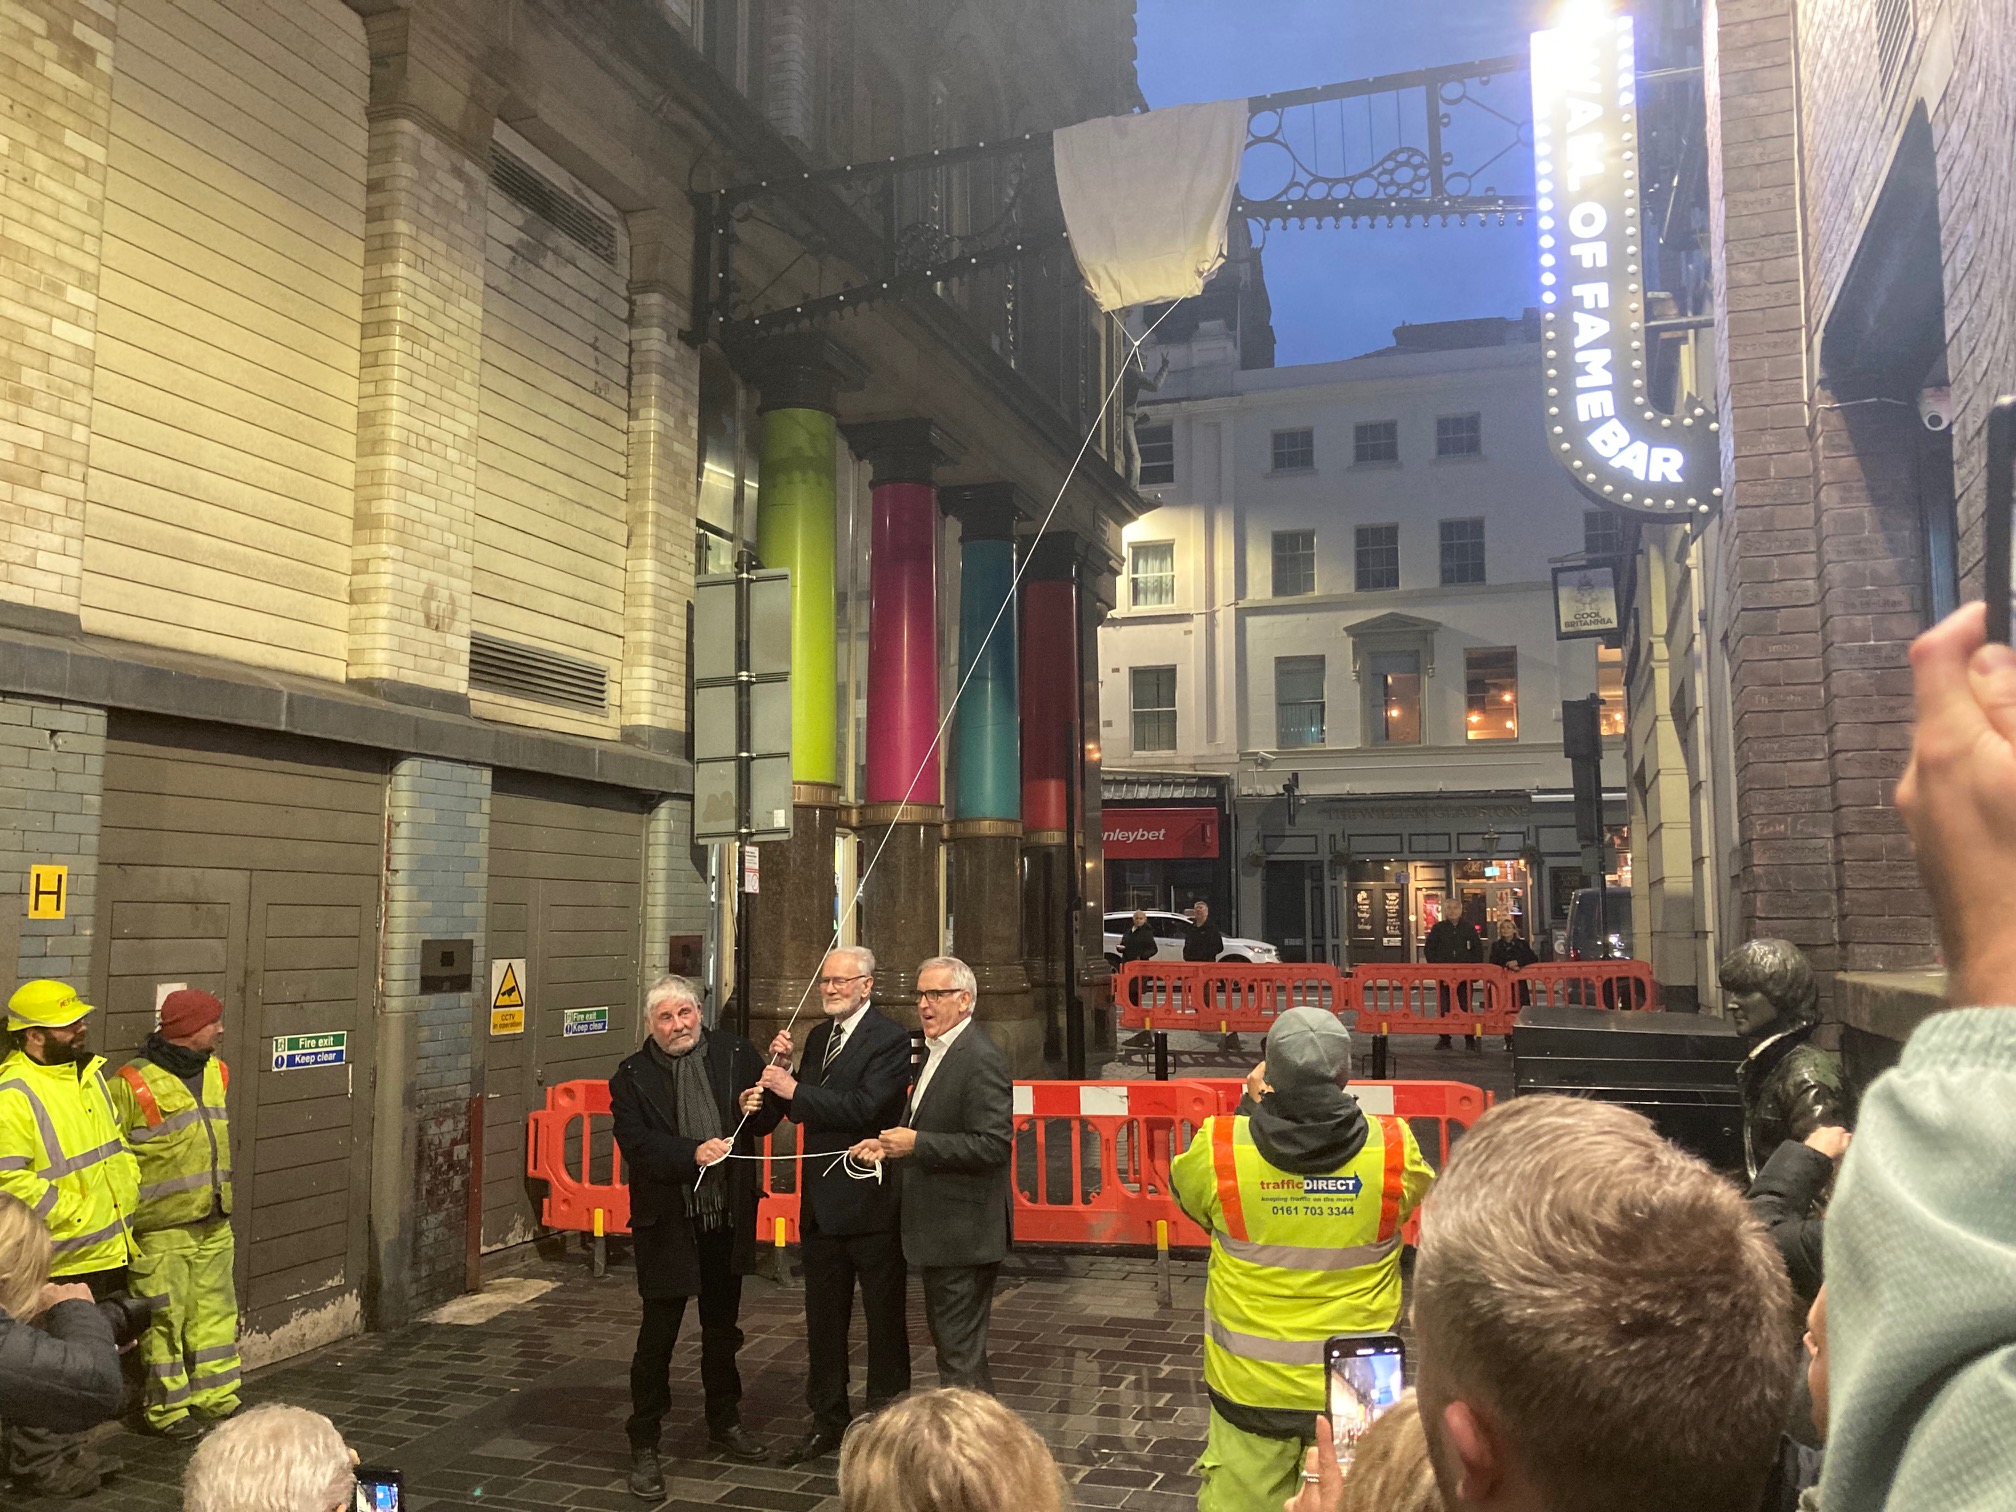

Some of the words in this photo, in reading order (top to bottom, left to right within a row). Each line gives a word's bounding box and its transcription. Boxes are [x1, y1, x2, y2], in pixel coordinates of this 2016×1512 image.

[1568, 201, 1608, 268] OF
[1571, 281, 1614, 422] FAME
[1587, 422, 1684, 483] BAR
[1573, 611, 1602, 620] COOL
[1564, 617, 1613, 628] BRITANNIA
[1101, 828, 1167, 844] nleybet
[34, 873, 63, 911] H
[501, 1013, 516, 1021] CCTV
[573, 1011, 585, 1021] Fire
[585, 1011, 597, 1021] exit
[499, 1021, 522, 1030] operation
[572, 1022, 588, 1034] Keep
[589, 1021, 604, 1031] clear
[299, 1037, 316, 1048] Fire
[318, 1036, 334, 1047] exit
[295, 1054, 315, 1065] Keep
[316, 1052, 336, 1062] clear
[1272, 1206, 1299, 1216] 0161
[1303, 1206, 1324, 1216] 703
[1327, 1206, 1355, 1216] 3344
